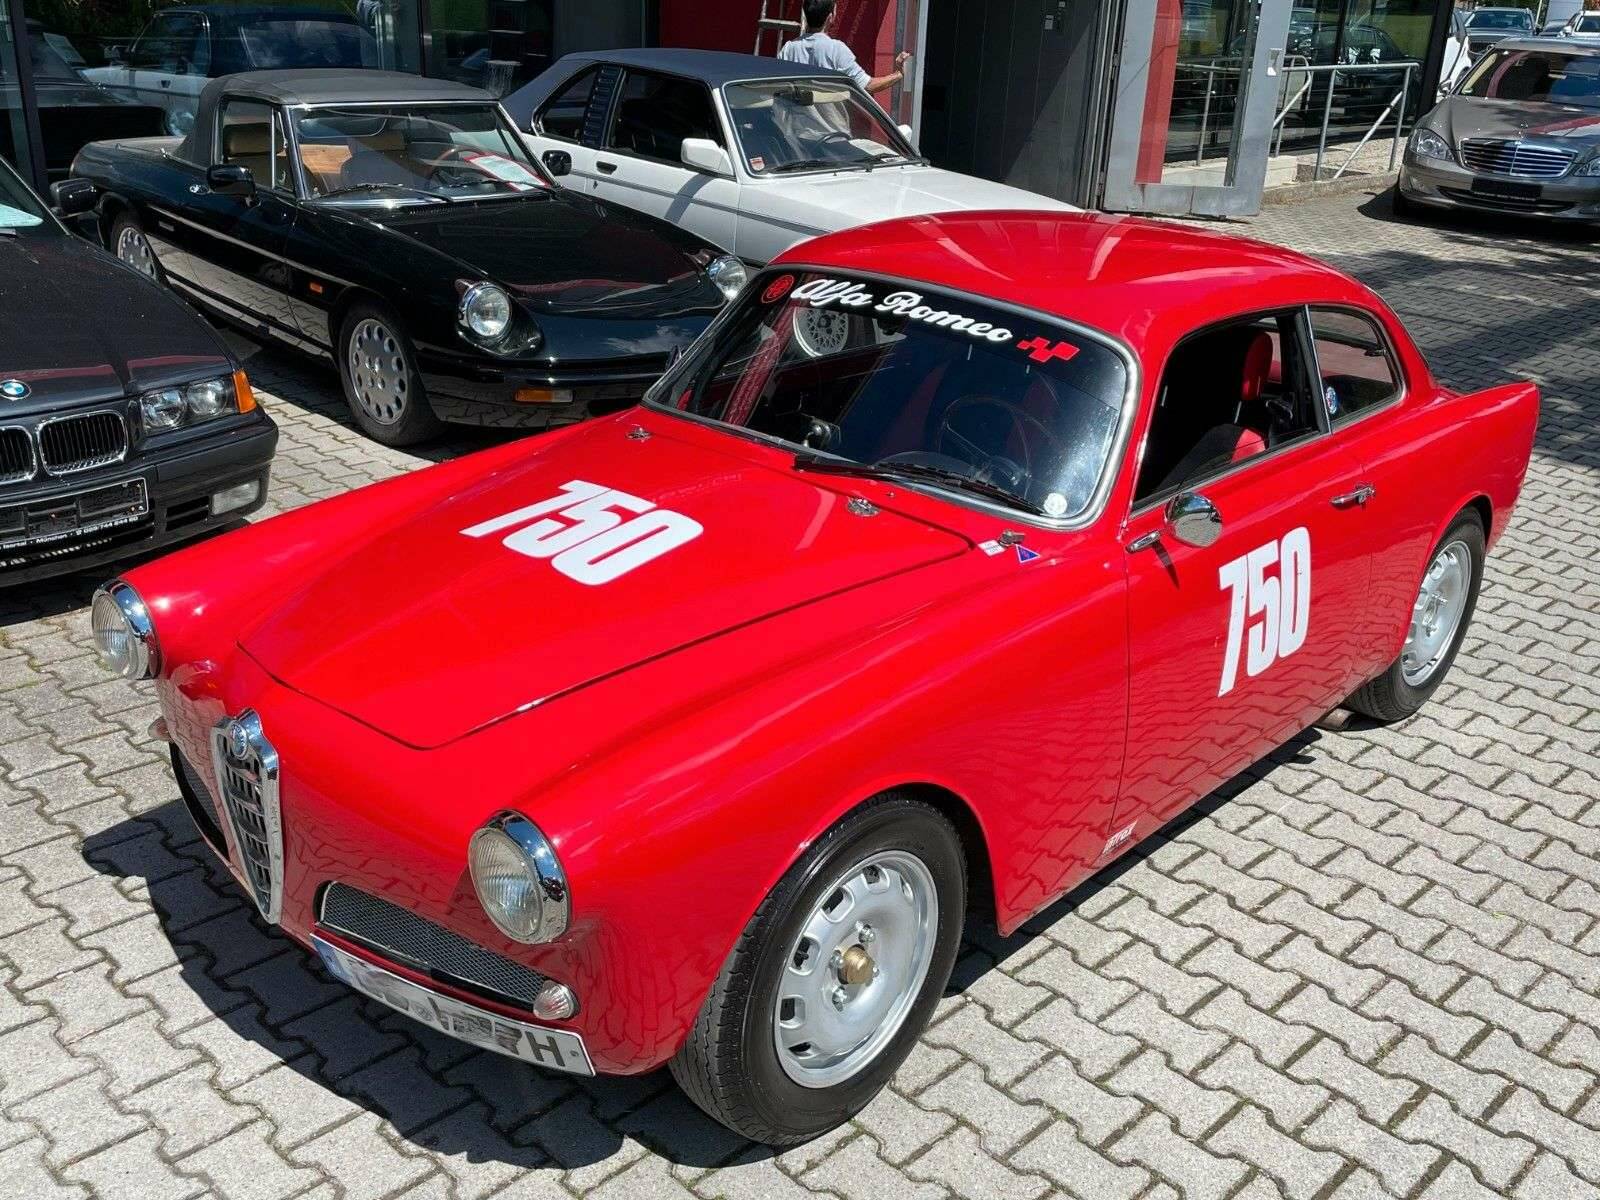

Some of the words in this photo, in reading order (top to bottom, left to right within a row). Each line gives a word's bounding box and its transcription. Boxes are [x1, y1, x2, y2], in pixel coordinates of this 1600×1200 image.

[790, 278, 873, 306] Alfa
[874, 291, 1013, 341] Romeo
[458, 479, 704, 586] 750
[1217, 526, 1311, 697] 750
